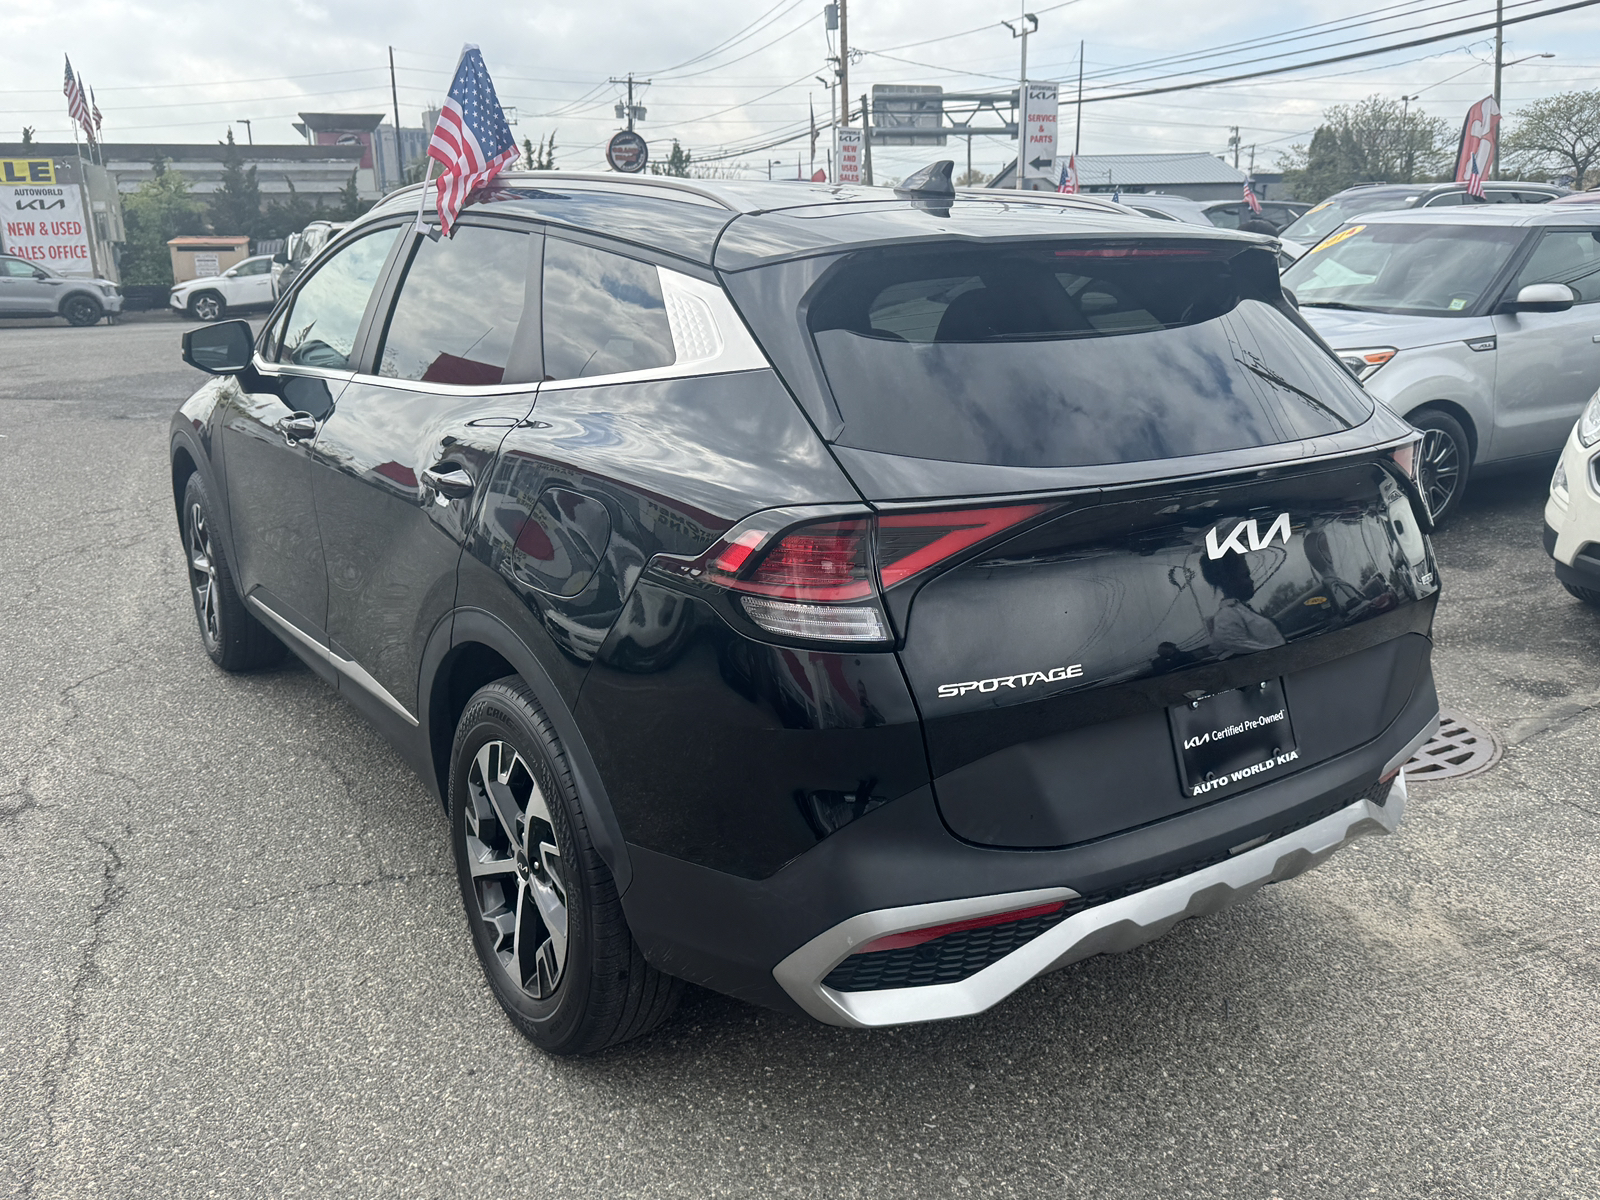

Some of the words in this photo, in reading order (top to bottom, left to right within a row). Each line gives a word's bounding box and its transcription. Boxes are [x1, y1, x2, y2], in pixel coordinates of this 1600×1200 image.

[1029, 91, 1057, 100] KIA
[1028, 114, 1056, 123] SERVICE
[1038, 125, 1045, 133] &
[1030, 135, 1053, 143] PARTS
[842, 145, 857, 153] NEW
[0, 161, 52, 182] LE
[841, 164, 858, 172] USED
[839, 174, 859, 182] SALES
[14, 188, 63, 196] AUTOWORLD
[16, 199, 66, 210] KIA
[7, 222, 35, 236] NEW
[39, 222, 49, 235] &
[51, 221, 82, 235] USED
[9, 246, 46, 260] SALES
[48, 245, 88, 259] OFFICE
[1204, 512, 1292, 561] KIA
[937, 663, 1083, 699] SPORTAGE
[1183, 732, 1210, 750] KIA
[1211, 724, 1244, 741] Certified
[1245, 711, 1284, 731] Pre-Owned
[1193, 776, 1229, 796] AUTO
[1231, 759, 1274, 782] WORLD
[1277, 750, 1299, 765] KIA
